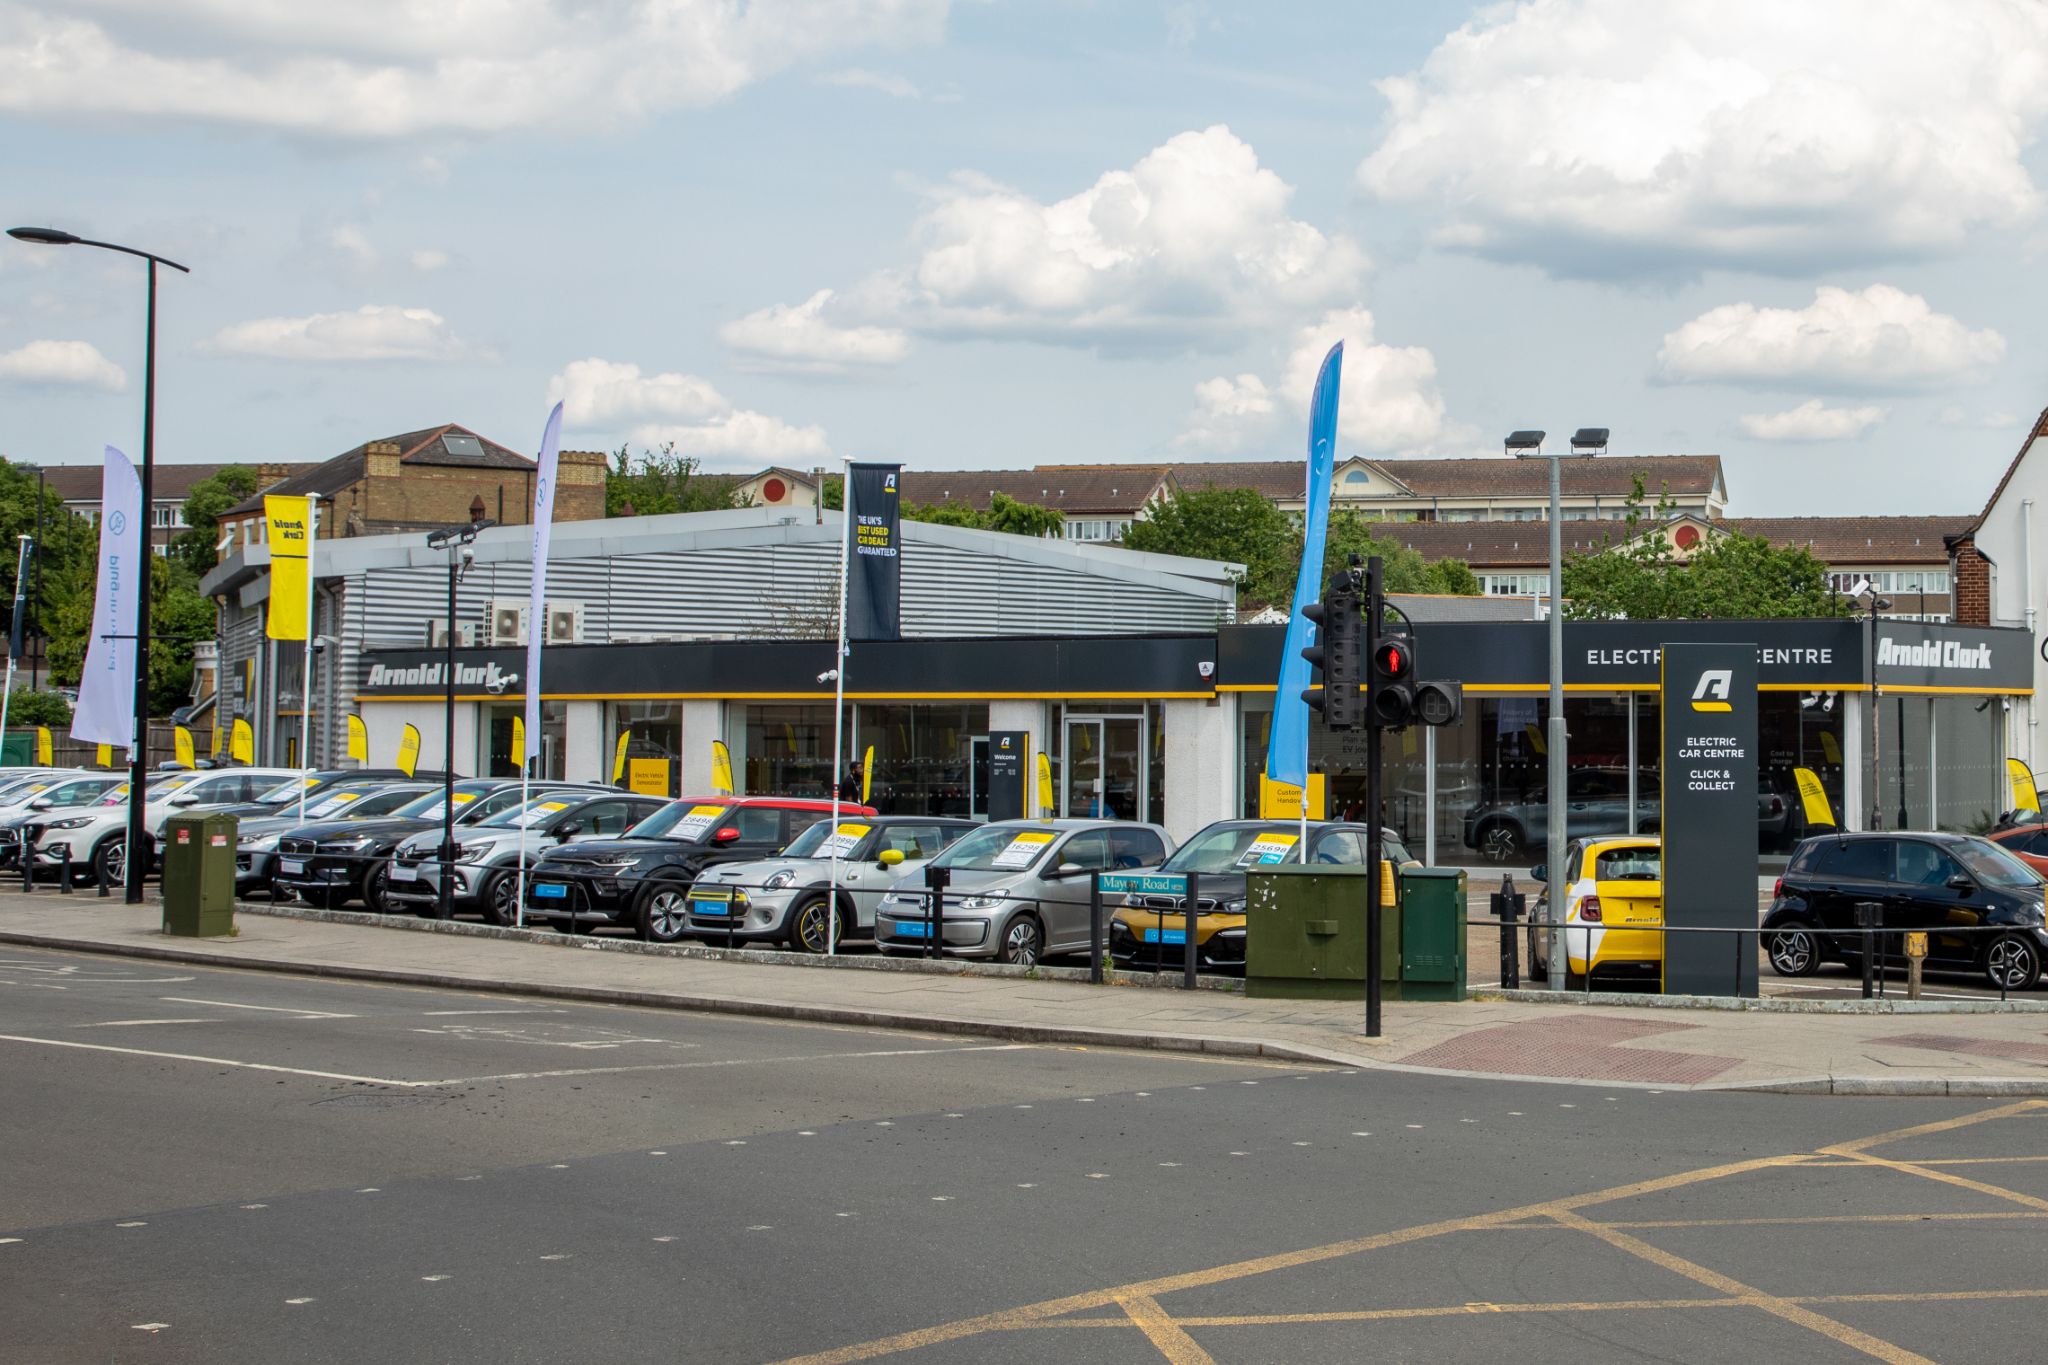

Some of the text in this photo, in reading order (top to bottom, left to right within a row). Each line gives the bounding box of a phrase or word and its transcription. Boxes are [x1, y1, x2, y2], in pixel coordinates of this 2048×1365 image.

[870, 527, 889, 535] USED
[1587, 648, 1833, 665] ELECTR ENTRE
[1877, 637, 1992, 669] Arnold Clark
[367, 663, 442, 686] Arnold
[1686, 737, 1737, 747] ELECTRIC
[1679, 749, 1745, 758] CAR CENTRE
[1689, 770, 1731, 779] CLICK &
[1687, 781, 1736, 791] COLLECT
[1276, 788, 1302, 796] Custom
[1253, 843, 1288, 853] 25698
[1142, 877, 1170, 890] Road
